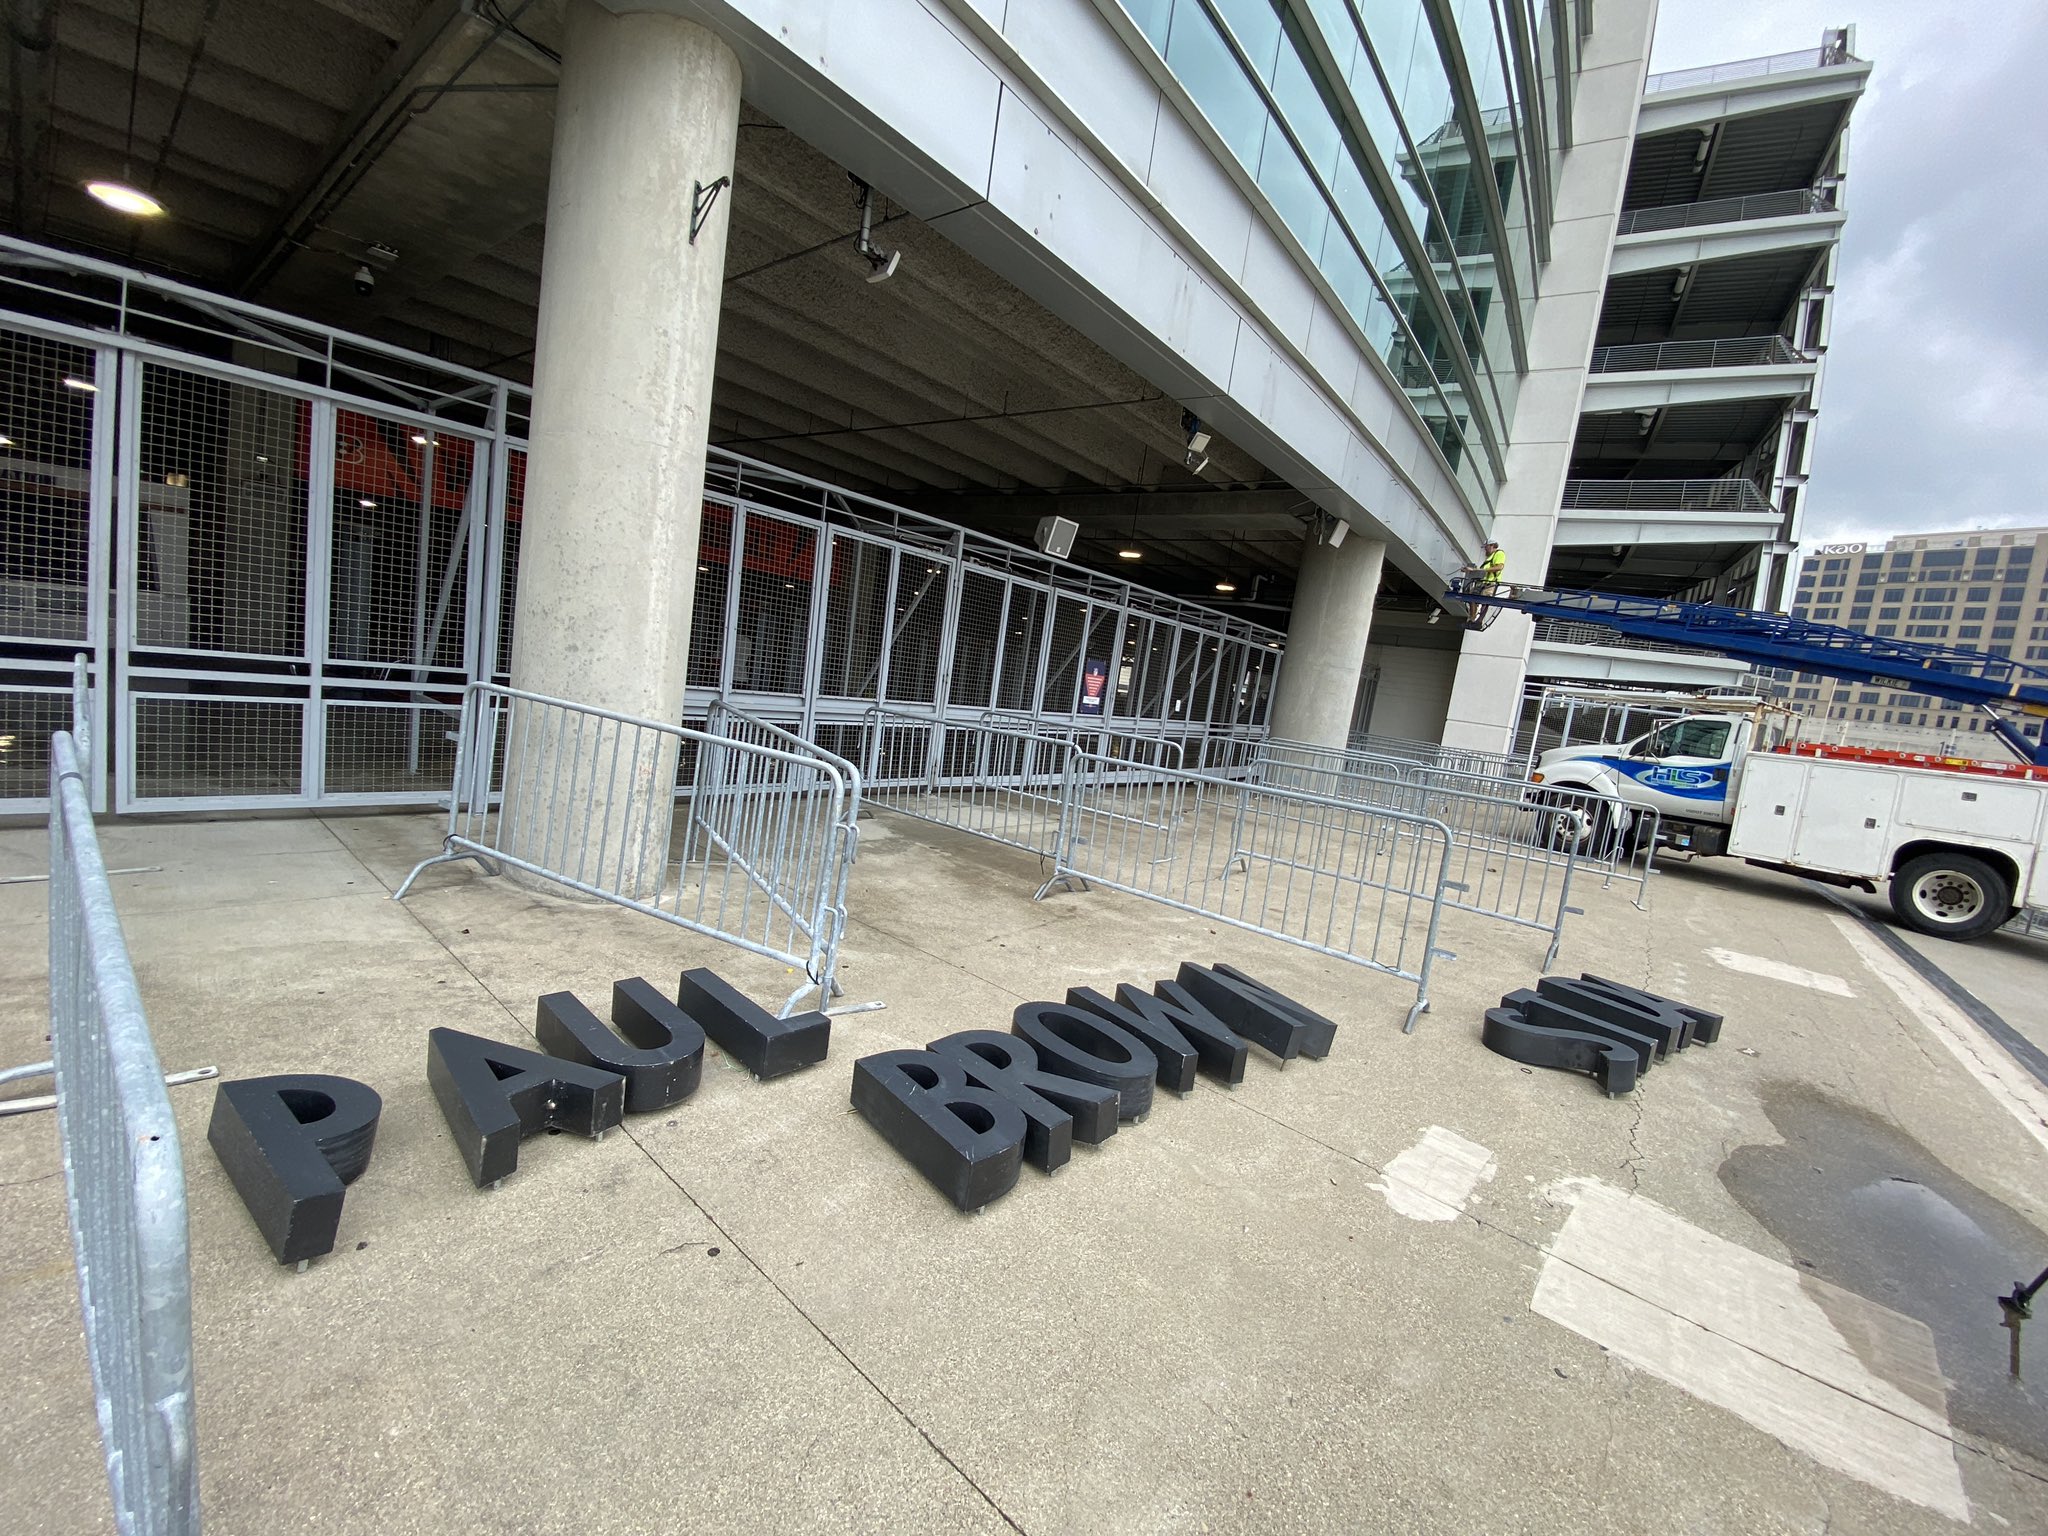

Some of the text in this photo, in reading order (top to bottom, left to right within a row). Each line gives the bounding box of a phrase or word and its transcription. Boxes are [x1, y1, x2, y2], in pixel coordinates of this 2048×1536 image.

[1651, 766, 1702, 785] HLS
[207, 967, 831, 1265] PAUL
[850, 961, 1338, 1213] BROWN
